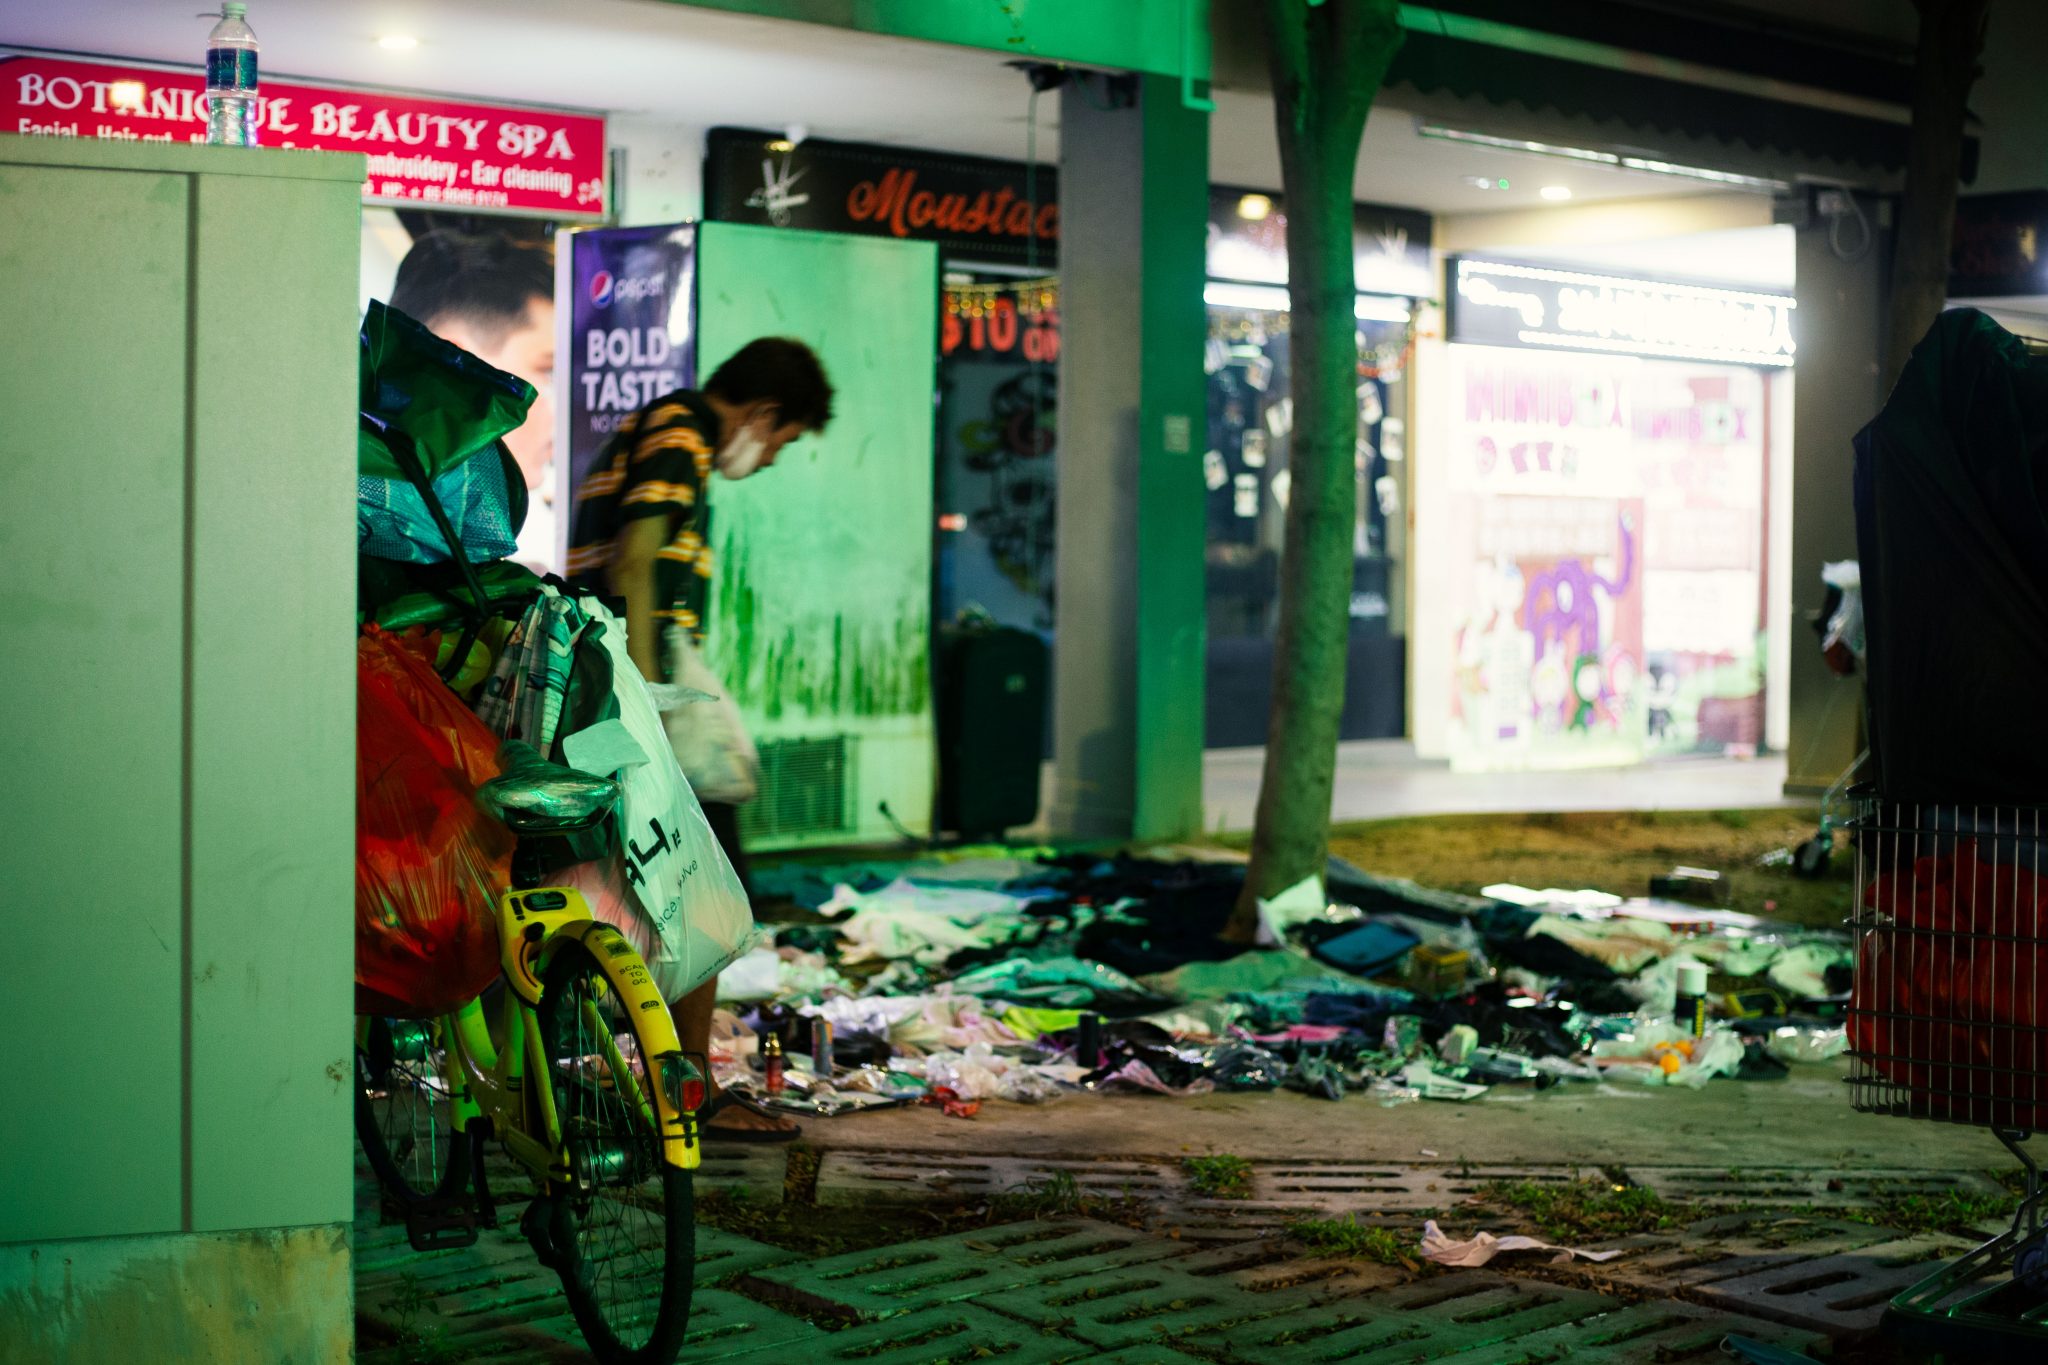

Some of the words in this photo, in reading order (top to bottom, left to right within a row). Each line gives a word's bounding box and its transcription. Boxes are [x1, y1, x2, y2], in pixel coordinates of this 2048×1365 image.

[310, 102, 488, 151] BEAUTY
[497, 121, 575, 160] SPA
[367, 151, 459, 188] mbroidery
[472, 159, 502, 187] Ear
[502, 163, 573, 199] cleaning
[587, 326, 670, 368] BOLD
[581, 371, 676, 411] TASTE
[590, 414, 611, 433] NO
[618, 964, 645, 975] SCAN
[630, 970, 643, 978] TO
[632, 977, 647, 986] GO
